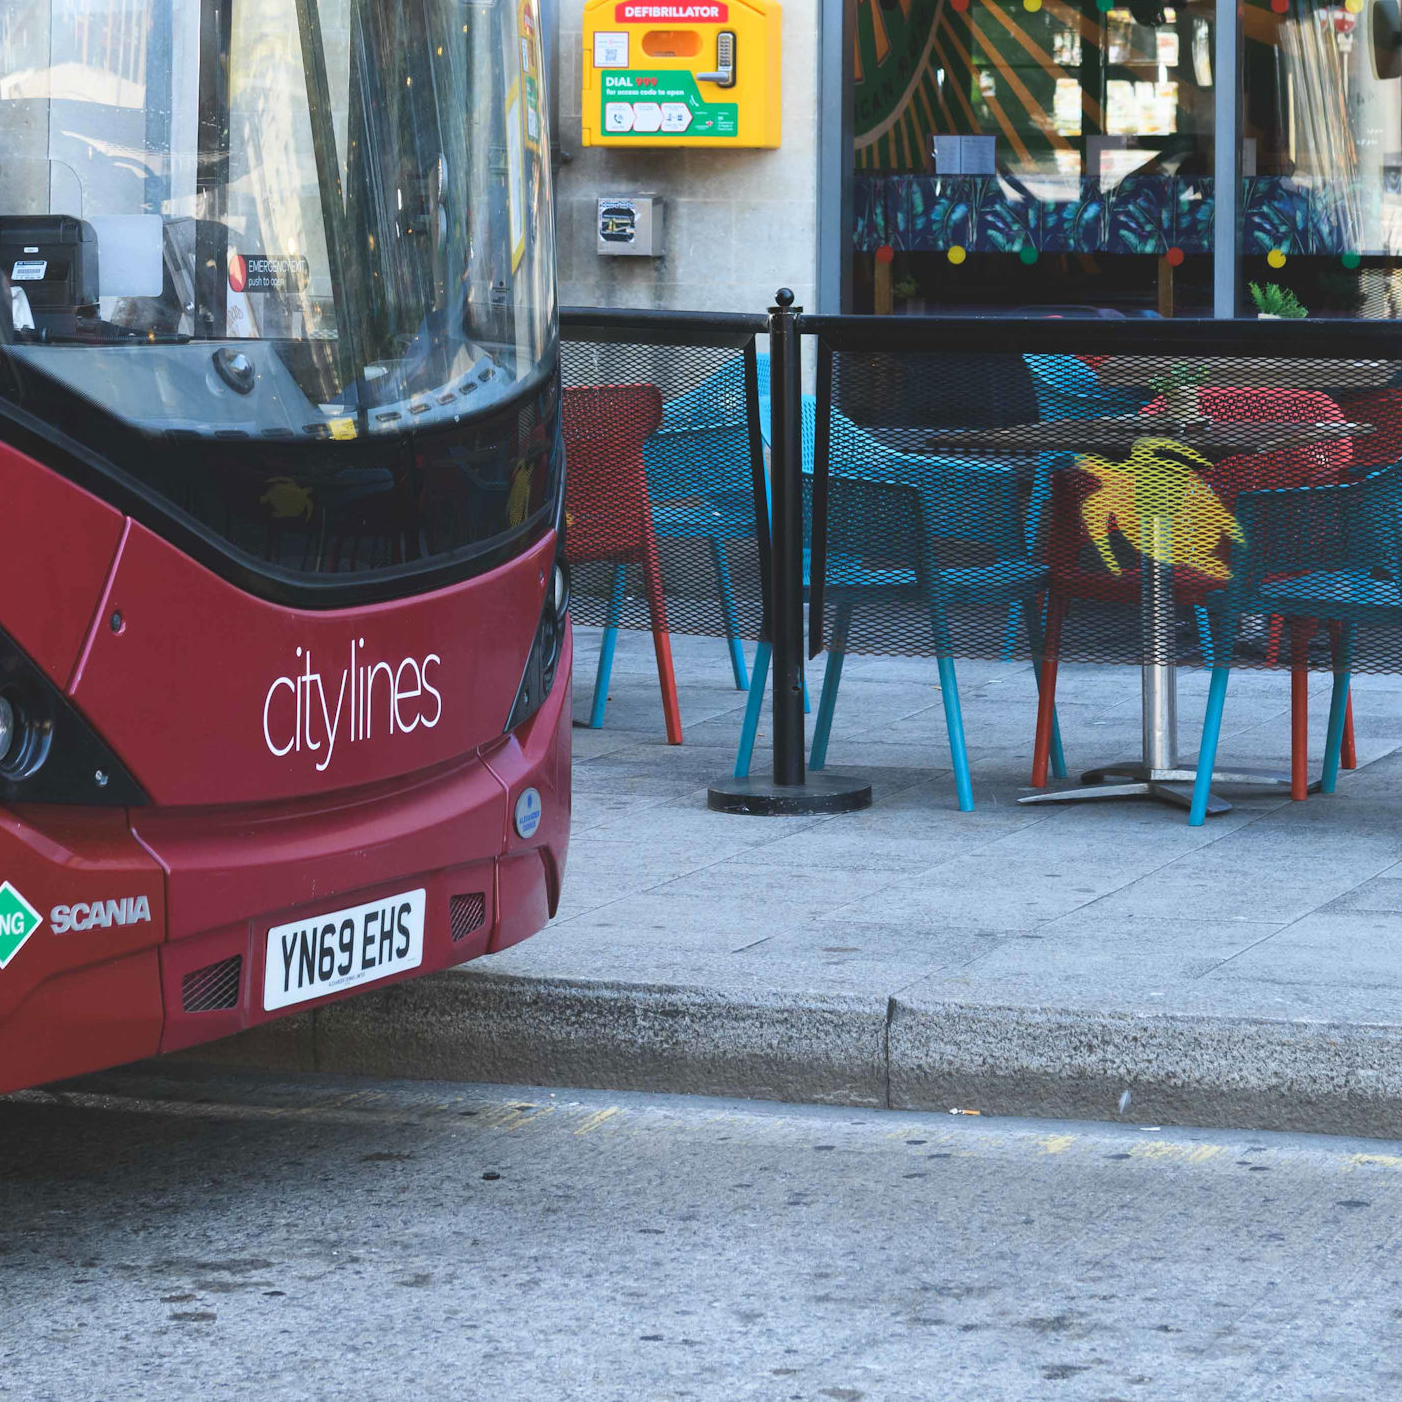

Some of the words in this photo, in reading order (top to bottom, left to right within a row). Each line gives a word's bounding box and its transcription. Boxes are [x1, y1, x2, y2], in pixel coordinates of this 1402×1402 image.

[624, 6, 719, 18] DEFIBRILLATOR
[605, 76, 633, 87] DIAL
[635, 76, 658, 87] 999
[606, 88, 616, 96] for
[640, 88, 657, 96] code
[658, 88, 665, 96] to
[666, 89, 685, 97] open
[248, 260, 291, 273] EMERGENCY
[291, 259, 305, 272] EXIT
[248, 275, 262, 289] push
[263, 277, 269, 287] to
[270, 278, 284, 289] open
[263, 639, 443, 772] citylines
[50, 894, 152, 936] SCANIA
[281, 918, 355, 993] YN69
[361, 902, 412, 971] EHS
